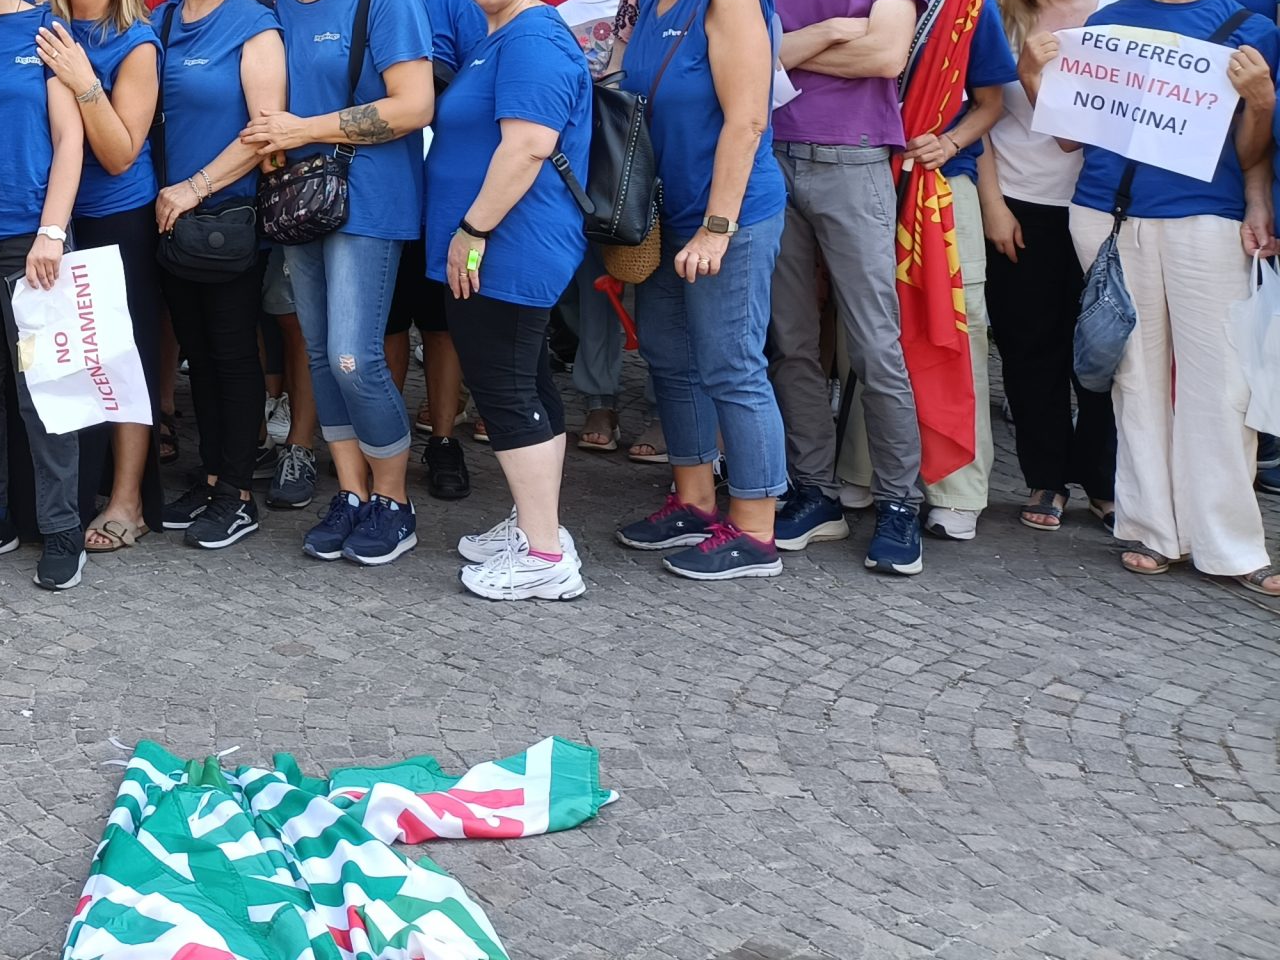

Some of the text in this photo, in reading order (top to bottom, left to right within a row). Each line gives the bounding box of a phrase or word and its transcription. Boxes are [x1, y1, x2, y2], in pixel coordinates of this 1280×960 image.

[1081, 31, 1210, 74] PEG PEREGO
[1060, 57, 1219, 110] MADE IN ITALY?
[1073, 91, 1188, 136] NO IN CINA!
[54, 331, 71, 363] NO
[71, 264, 119, 411] LICENZIAMENTI
